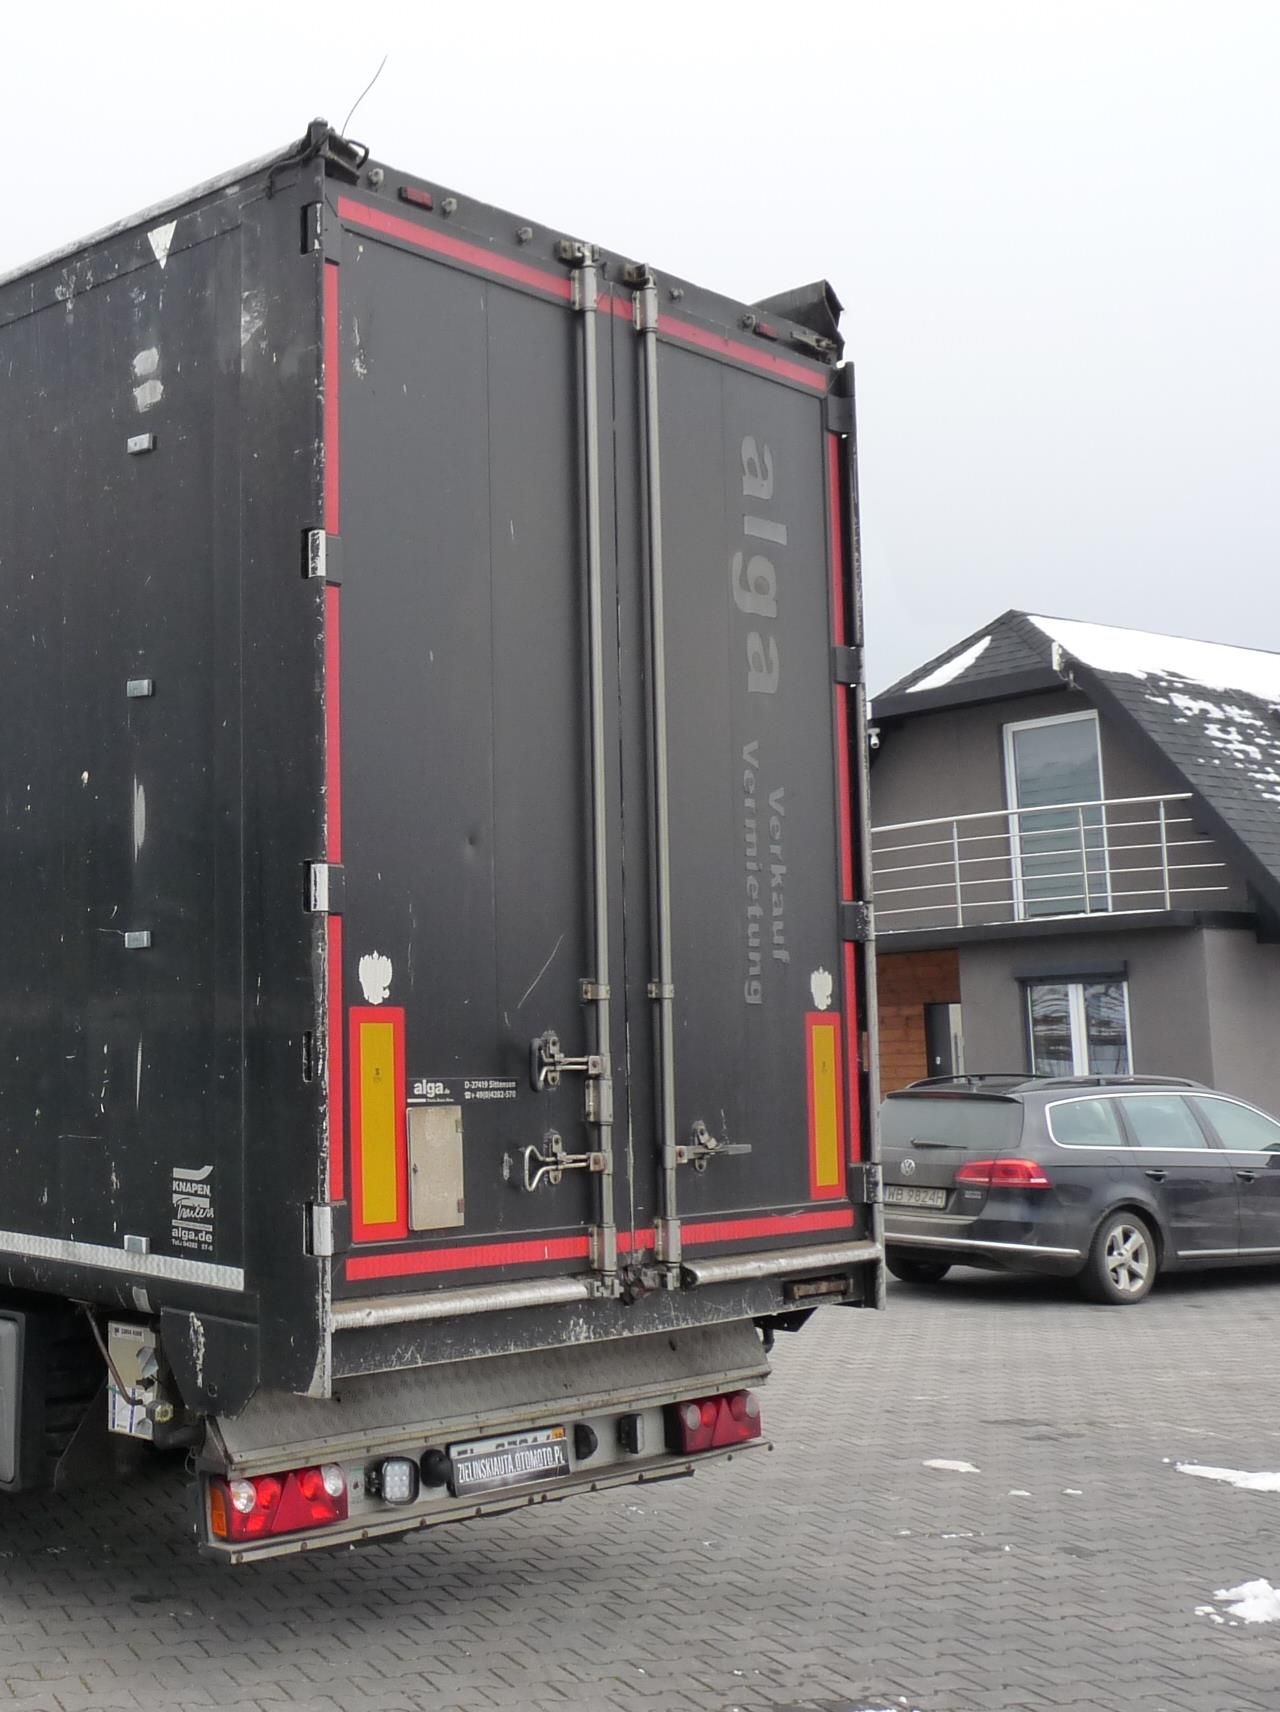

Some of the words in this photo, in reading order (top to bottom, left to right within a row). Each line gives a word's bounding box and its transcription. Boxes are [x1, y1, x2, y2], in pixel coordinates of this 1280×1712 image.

[731, 435, 788, 694] alga
[742, 740, 763, 1004] Vermietung
[769, 787, 791, 964] Verkauf
[172, 1227, 213, 1242] alga.de
[173, 1180, 210, 1196] KNAPEN
[887, 1187, 904, 1201] WB
[907, 1190, 945, 1206] 9824H
